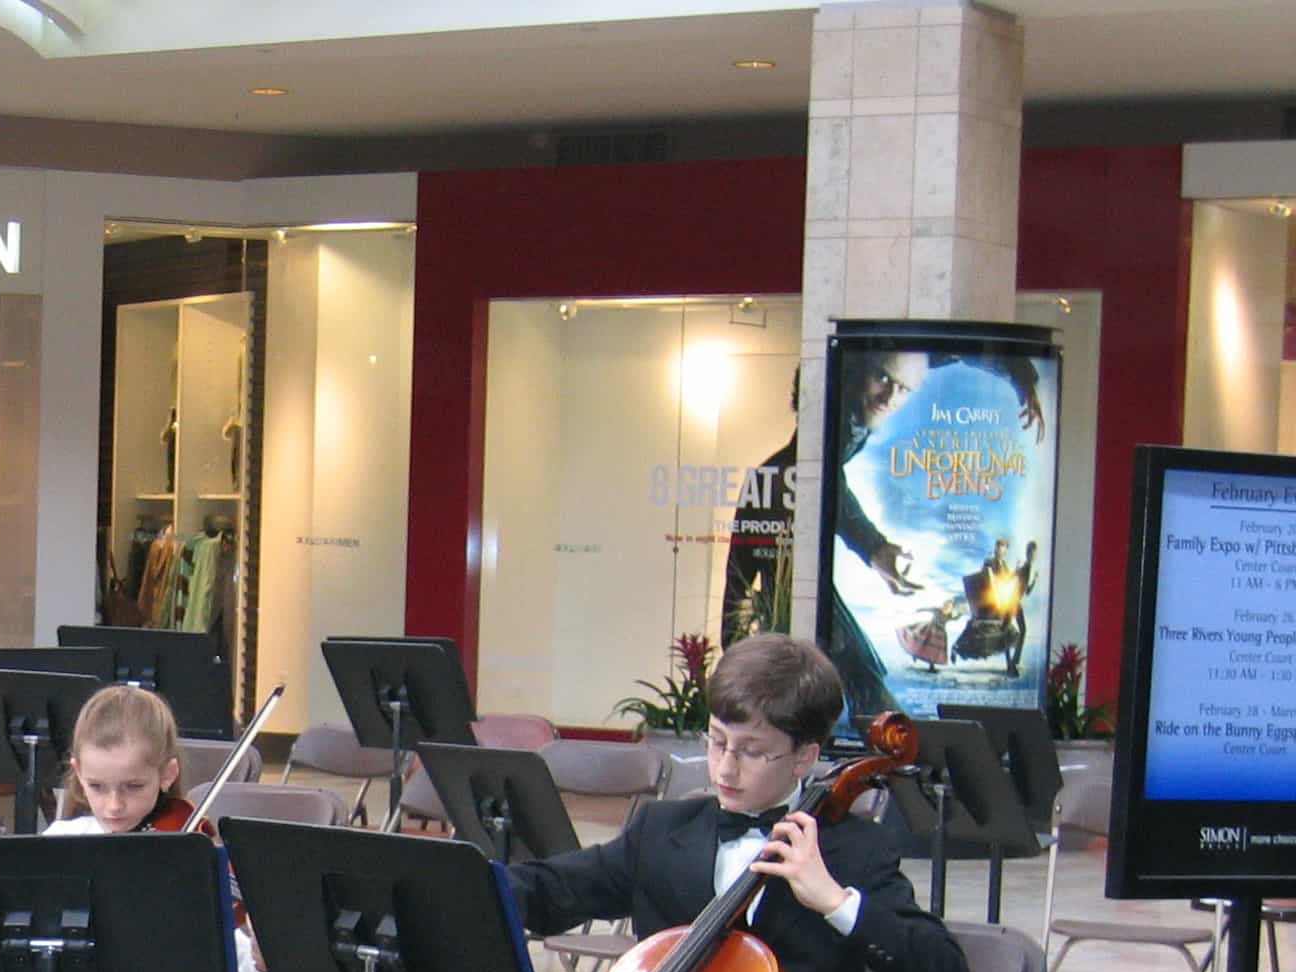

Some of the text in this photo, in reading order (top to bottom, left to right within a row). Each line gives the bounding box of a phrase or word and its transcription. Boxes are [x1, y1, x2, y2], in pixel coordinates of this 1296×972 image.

[931, 402, 952, 424] JIM
[890, 446, 1026, 478] UNFORTUNATE
[650, 464, 670, 508] 8
[678, 464, 779, 510] GREAT
[927, 468, 1003, 502] EVENTS
[1212, 482, 1275, 507] February
[1240, 520, 1282, 536] February
[1166, 534, 1205, 554] Family
[1210, 537, 1240, 556] Expo
[1245, 538, 1261, 556] w/
[1235, 560, 1268, 573] Center
[1246, 578, 1263, 589] AM
[1234, 609, 1277, 626] February
[1159, 626, 1188, 641] Three
[1192, 627, 1223, 641] Rivers
[1227, 629, 1262, 646] Young
[1229, 651, 1292, 665] Center Court
[1199, 702, 1241, 717] February
[1155, 720, 1180, 736] Ride
[1184, 725, 1199, 736] on
[1203, 721, 1222, 737] the
[1225, 722, 1262, 740] Bunny
[1223, 742, 1287, 755] Center Court
[1200, 826, 1240, 843] SIMON
